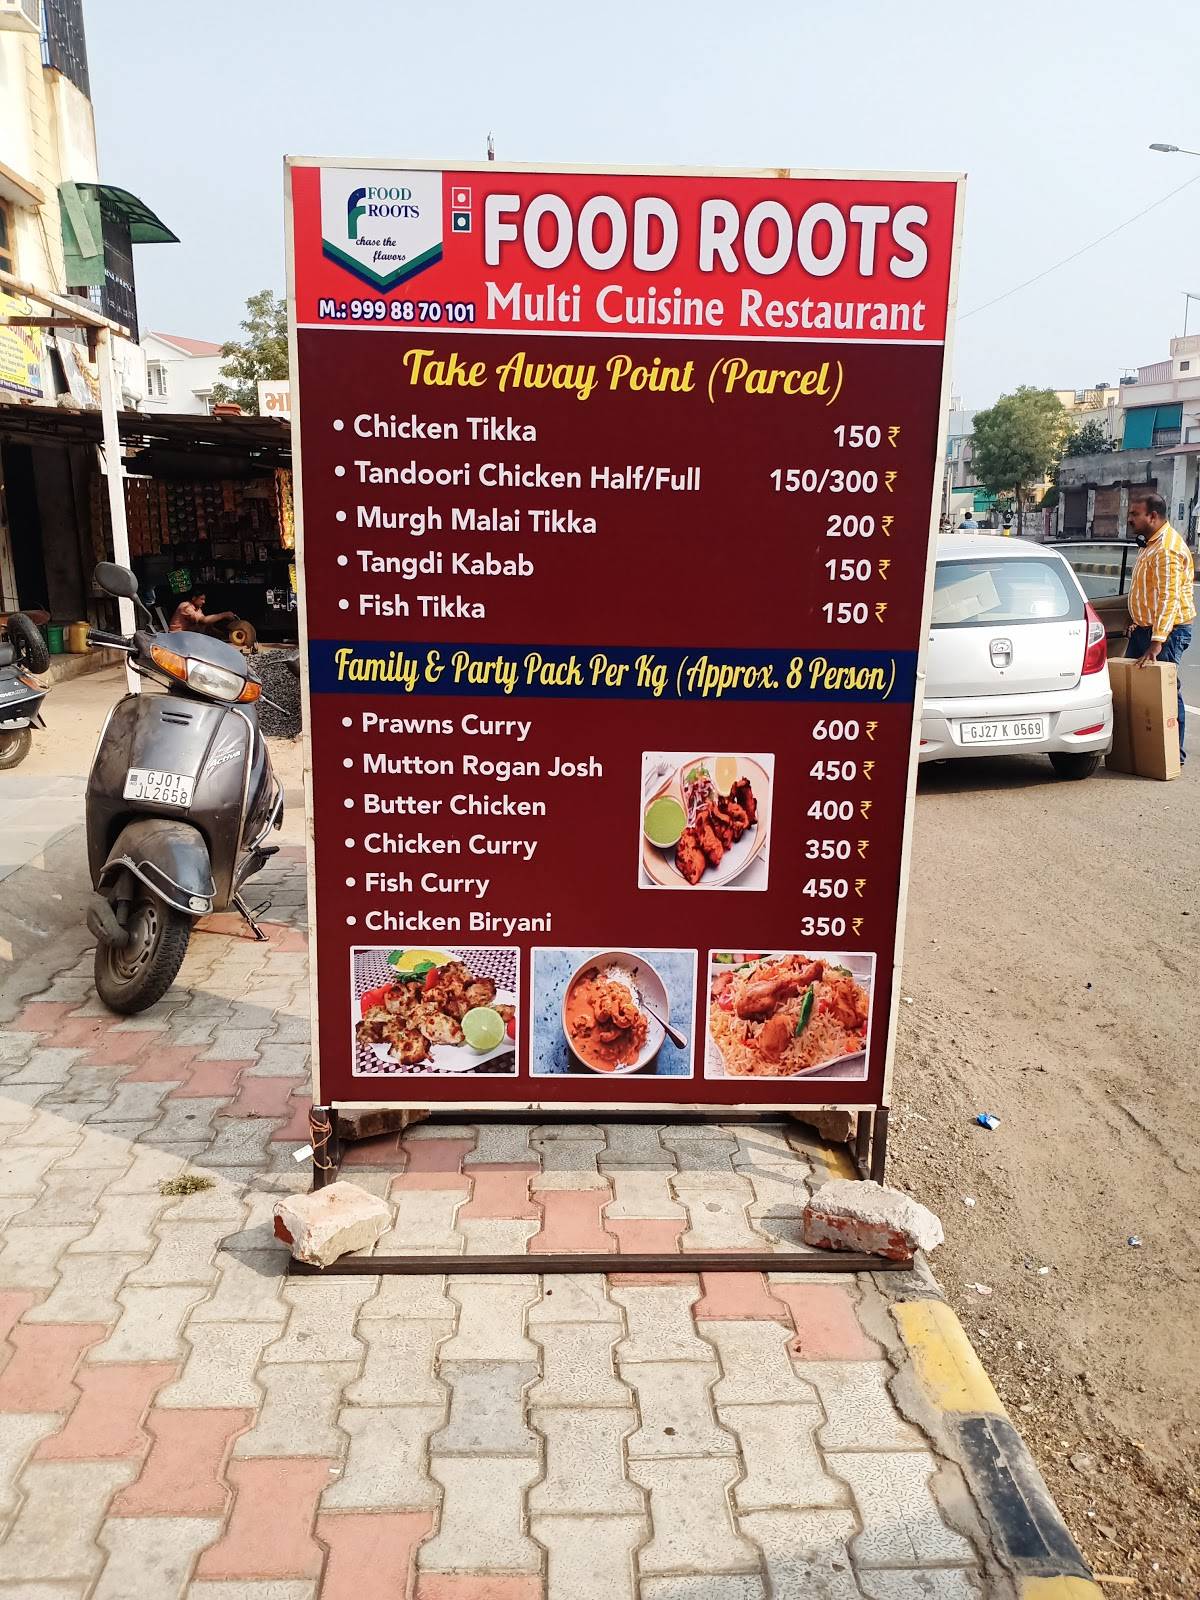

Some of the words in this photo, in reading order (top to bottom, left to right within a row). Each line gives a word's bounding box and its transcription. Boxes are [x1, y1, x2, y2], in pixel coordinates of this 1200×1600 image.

[367, 187, 412, 201] FOOD
[367, 204, 420, 219] ROOTS
[355, 236, 381, 247] chase
[382, 236, 397, 247] the
[485, 193, 679, 272] FOOD
[699, 199, 928, 279] ROOTS
[372, 250, 406, 263] flavors
[318, 299, 347, 319] M.:
[350, 299, 386, 320] 999
[390, 300, 414, 321] 88
[418, 301, 442, 322] 70
[445, 302, 475, 323] 101
[484, 281, 581, 322] Multi
[596, 284, 724, 326] Cuisine
[739, 288, 926, 332] Restaurant
[402, 348, 488, 387] Take
[495, 351, 599, 401] Away
[605, 354, 696, 393] Point
[708, 356, 844, 407] (Parcel)
[353, 413, 459, 440] Chicken
[465, 416, 537, 442] Tikka
[833, 424, 882, 449] 150
[353, 460, 471, 486] Tandoori
[478, 462, 582, 489] Chicken
[590, 465, 701, 491] Half/Full
[769, 468, 879, 494] 150/300
[356, 505, 442, 537] Murgh
[451, 507, 521, 532] Malai
[527, 508, 597, 534] Tikka
[826, 514, 875, 538] 200
[356, 550, 443, 581] Tangdi
[452, 551, 534, 577] Kabab
[824, 558, 872, 582] 150
[359, 593, 410, 617] Fish
[416, 594, 486, 619] Tikka
[822, 602, 869, 624] 150
[334, 647, 420, 693] Family
[424, 649, 446, 683] &
[451, 650, 519, 695] Party
[523, 652, 585, 686] Pack
[589, 653, 630, 687] Per
[634, 654, 669, 697] Kg
[676, 655, 779, 698] (Approx.
[786, 656, 804, 689] 8
[808, 656, 896, 700] Person)
[362, 712, 454, 735] Prawns
[461, 713, 532, 742] Curry
[812, 719, 860, 741] 600
[970, 724, 998, 739] GJ27
[1002, 724, 1009, 737] K
[1013, 722, 1042, 736] 0569
[363, 753, 454, 775] Mutton
[462, 754, 540, 782] Rogan
[547, 755, 603, 777] Josh
[809, 760, 857, 781] 450
[147, 771, 181, 789] GJ01
[135, 786, 188, 805] JL2658
[364, 793, 443, 815] Butter
[449, 793, 546, 816] Chicken
[806, 800, 854, 821] 400
[363, 832, 461, 854] Chicken
[468, 834, 538, 861] Curry
[805, 839, 851, 860] 350
[365, 871, 413, 893] Fish
[420, 872, 490, 899] Curry
[802, 878, 849, 899] 450
[365, 910, 461, 931] Chicken
[469, 911, 552, 938] Biryani
[800, 916, 846, 937] 350
